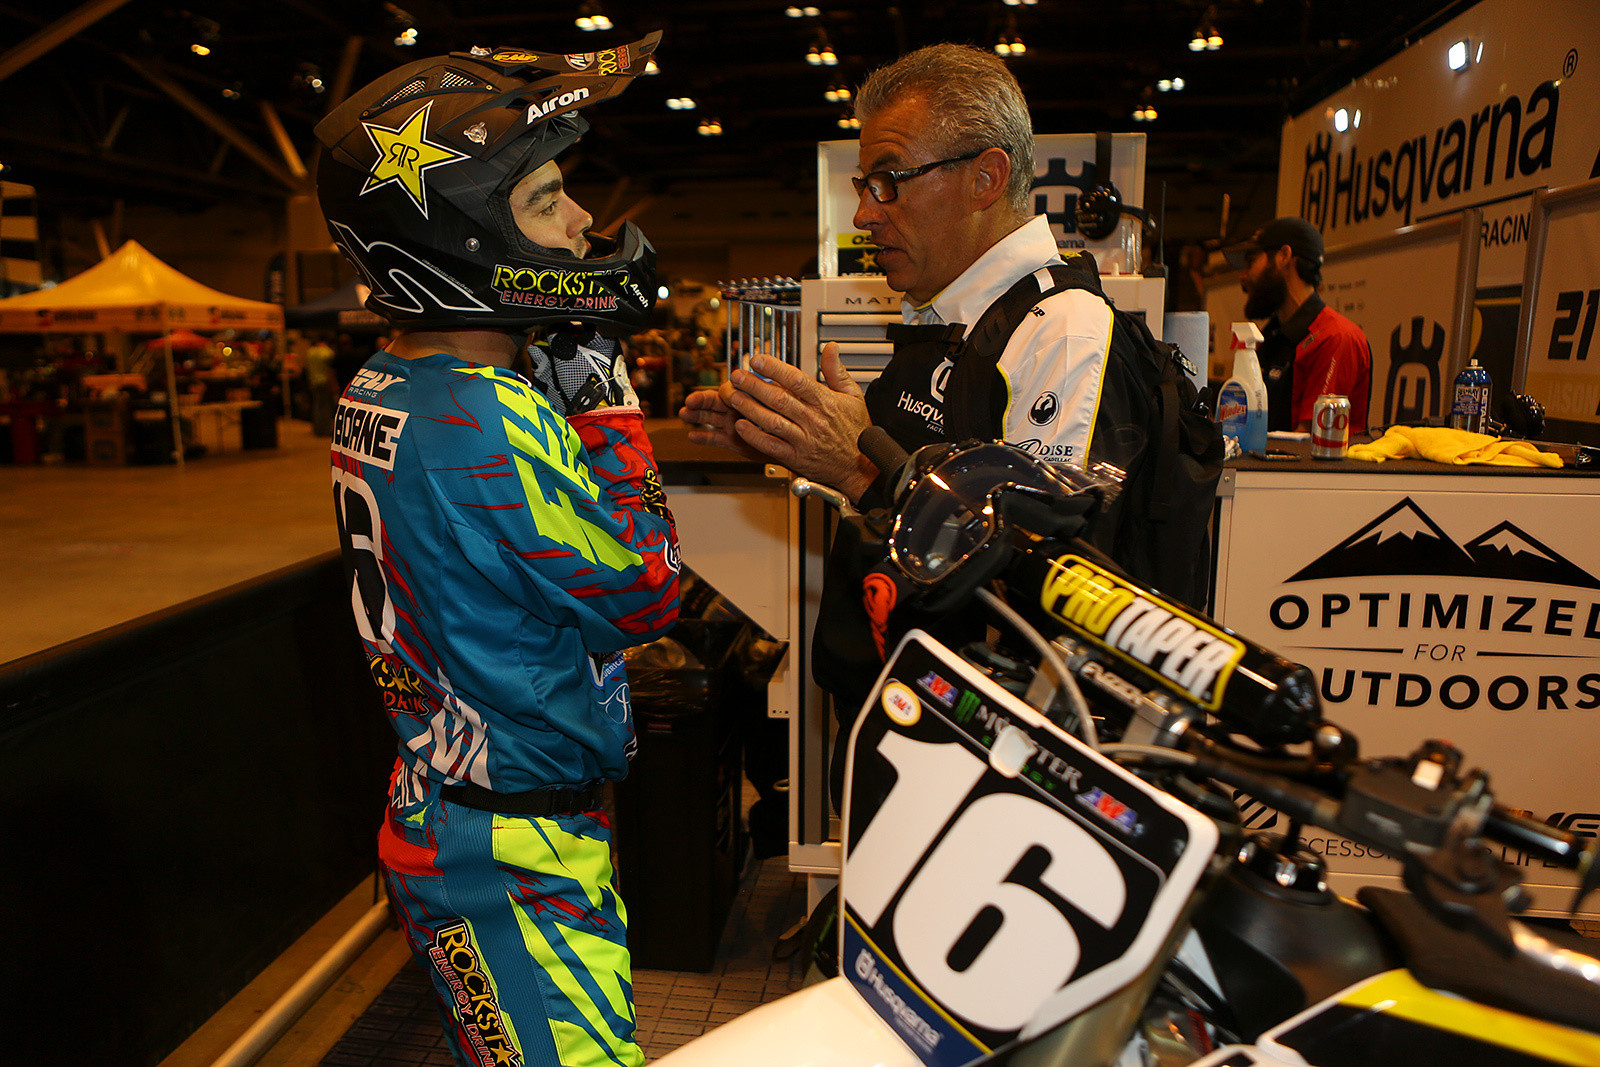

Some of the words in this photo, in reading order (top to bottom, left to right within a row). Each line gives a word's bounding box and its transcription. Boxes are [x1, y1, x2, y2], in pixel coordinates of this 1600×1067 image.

[1332, 79, 1560, 230] Husqvarna
[502, 289, 569, 307] ENERGY
[574, 295, 617, 310] DRINK
[348, 386, 379, 399] RACING
[897, 390, 945, 425] Husqv
[1050, 563, 1137, 636] PRO
[1103, 596, 1237, 700] TAPER
[1413, 644, 1466, 662] FOR
[1320, 667, 1600, 712] UTDOORS
[845, 729, 1127, 1032] 16
[431, 947, 474, 1016] ENERGY
